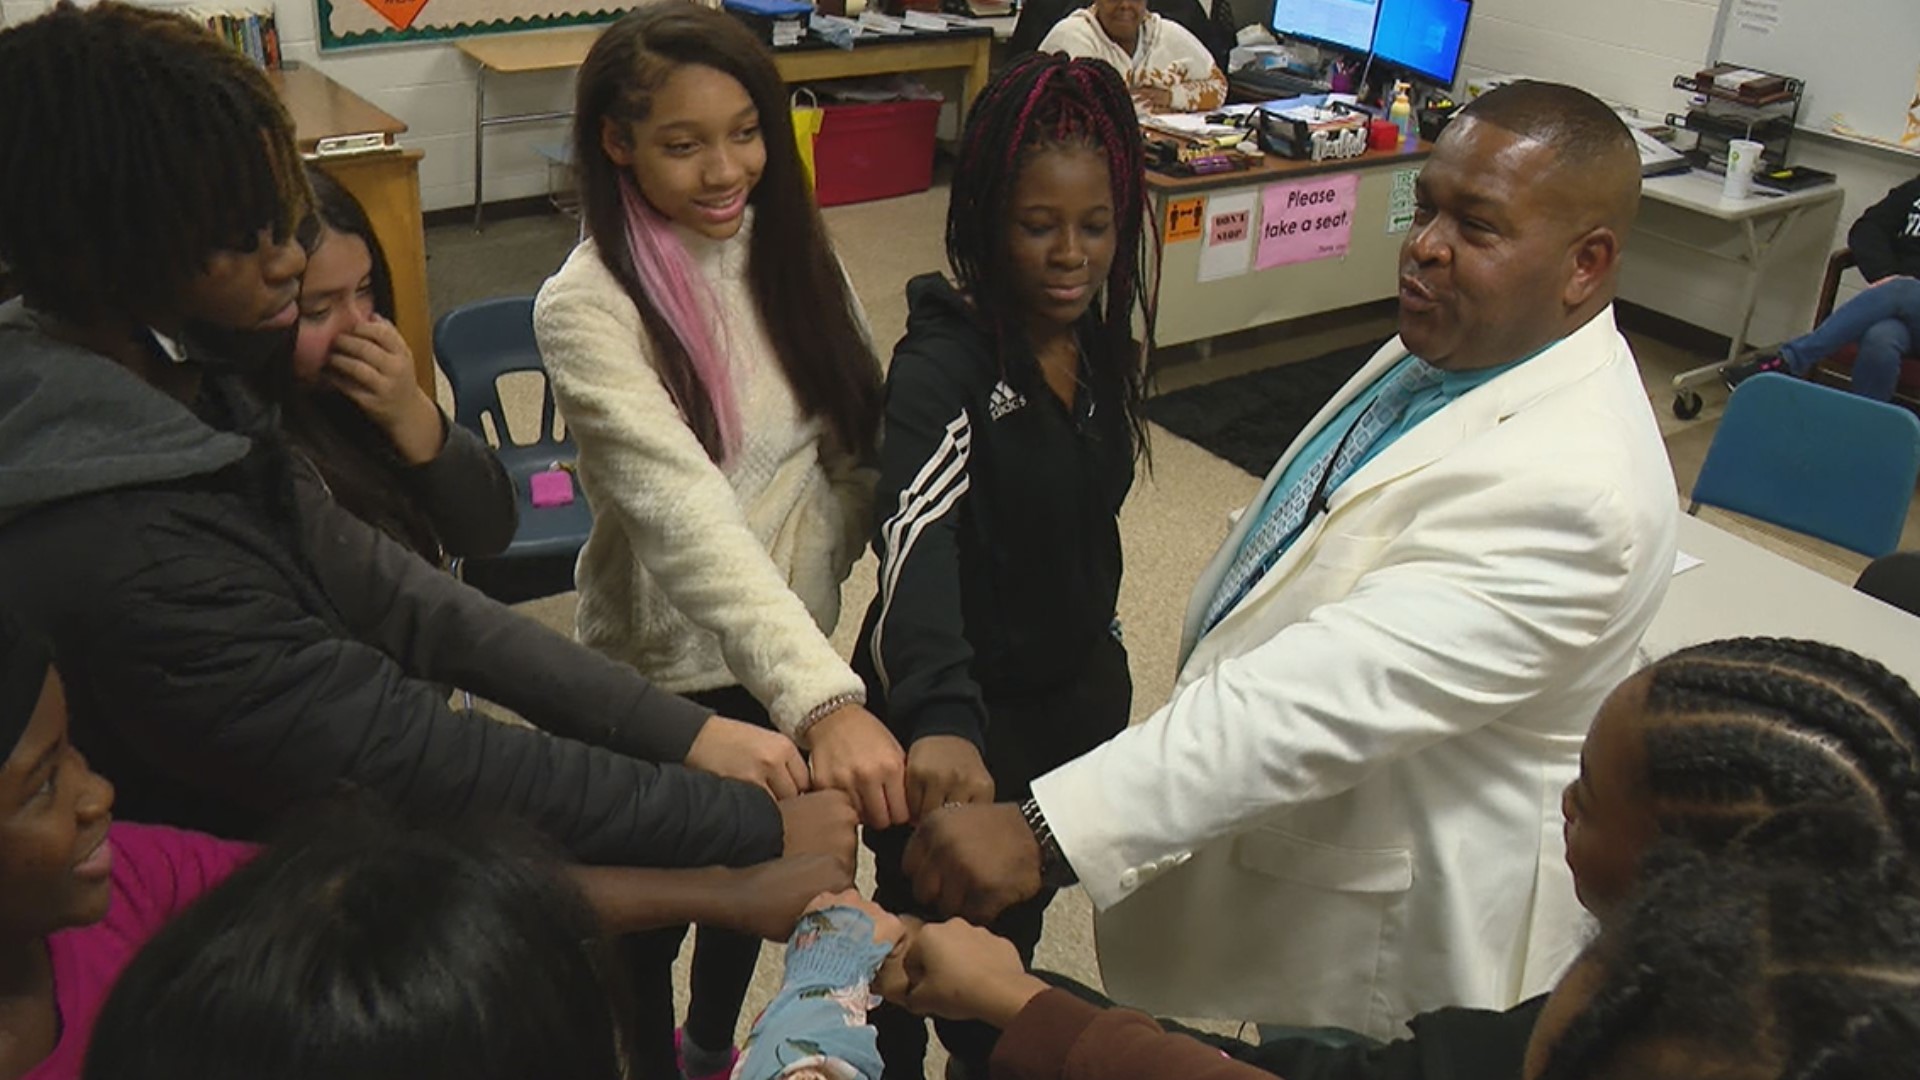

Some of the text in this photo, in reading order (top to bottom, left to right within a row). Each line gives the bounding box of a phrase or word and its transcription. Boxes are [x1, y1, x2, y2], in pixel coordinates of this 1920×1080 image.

[1287, 189, 1336, 209] Please
[1217, 228, 1243, 240] STOP
[1264, 220, 1297, 239] take
[1301, 219, 1312, 232] a
